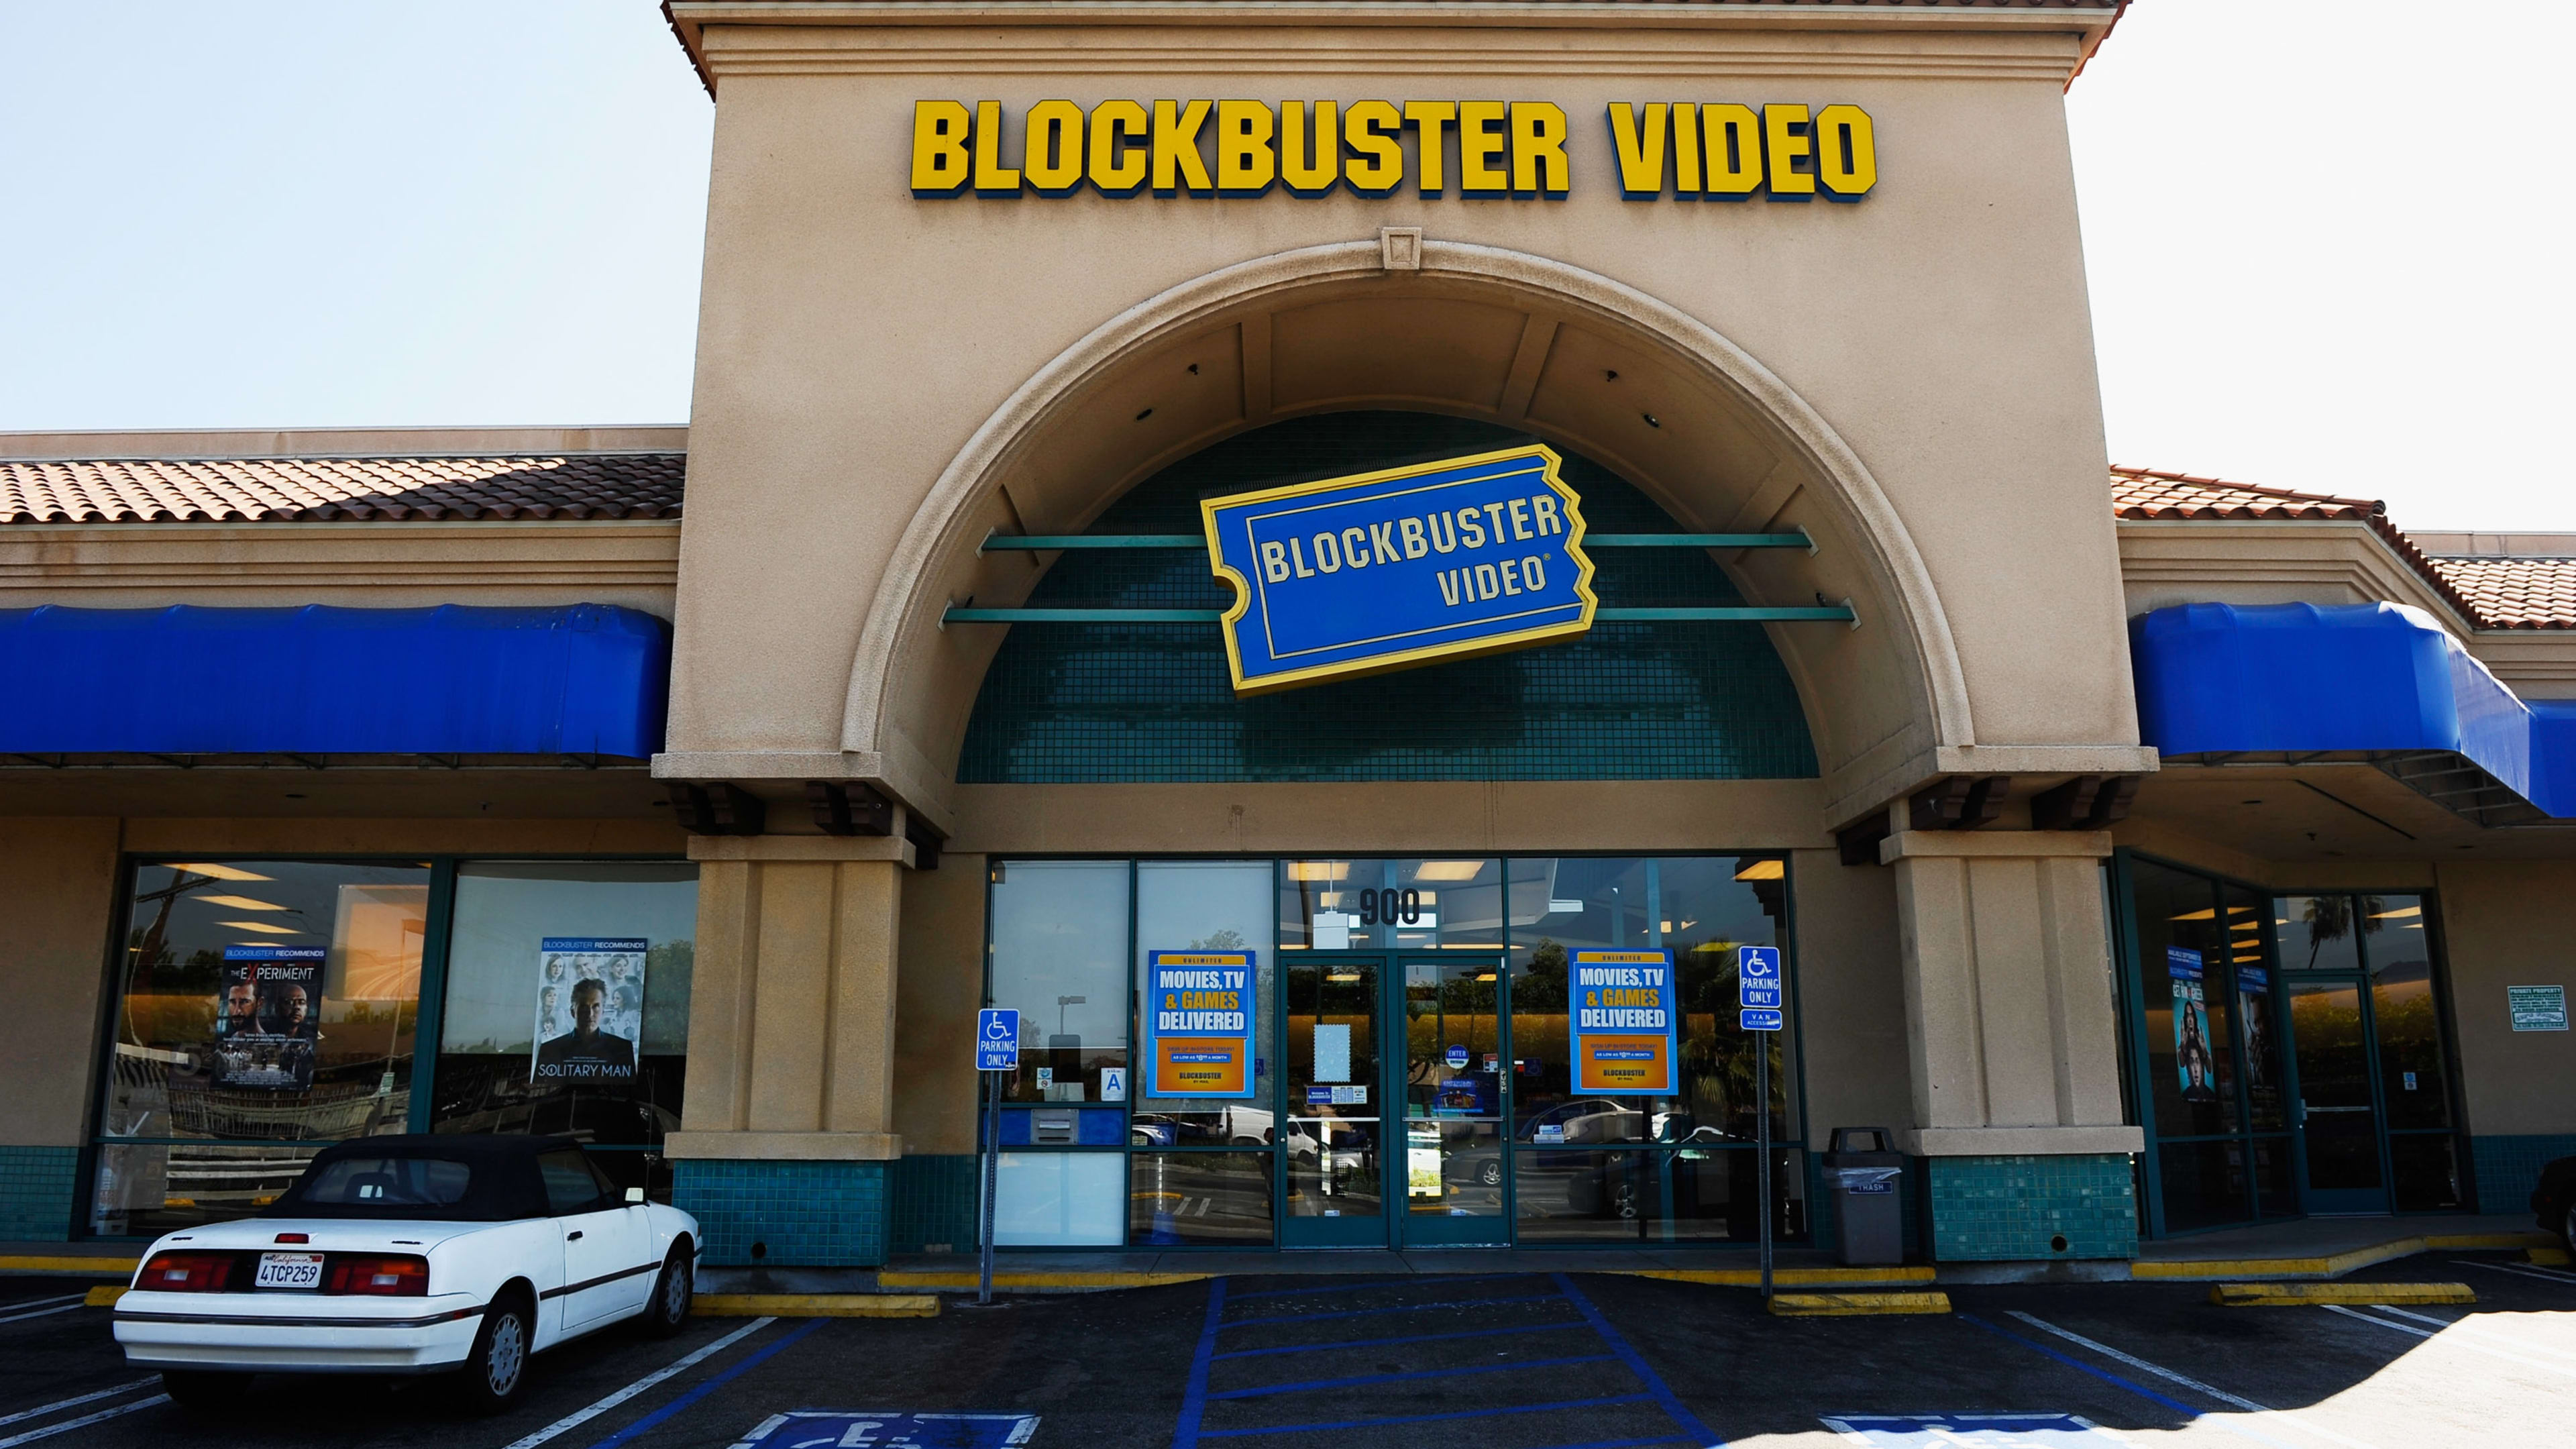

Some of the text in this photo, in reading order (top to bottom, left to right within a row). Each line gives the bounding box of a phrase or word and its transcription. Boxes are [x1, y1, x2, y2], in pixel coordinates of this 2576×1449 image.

[910, 99, 1877, 202] BLOCKBUSTER VIDEO
[1260, 494, 1562, 584] BLOCKBUSTER
[1360, 888, 1419, 925] 900
[240, 963, 314, 984] EXPERIMENT
[1160, 971, 1245, 990] MOVIES, TV
[1580, 968, 1664, 987] MOVIES, TV
[1742, 977, 1778, 989] PARKING
[1165, 991, 1239, 1010] & GAMES
[1587, 988, 1660, 1008] & GAMES
[1750, 991, 1772, 1003] ONLY
[1159, 1012, 1244, 1030] DELIVERED
[1580, 1008, 1666, 1028] DELIVERED
[981, 1040, 1015, 1052] PARKING
[987, 1054, 1008, 1066] ONLY
[538, 1064, 631, 1077] SOLITARY MAN
[1106, 1073, 1121, 1091] A
[1858, 1183, 1884, 1191] TRASH
[273, 1254, 312, 1265] California
[260, 1265, 318, 1283] 4TCP259
